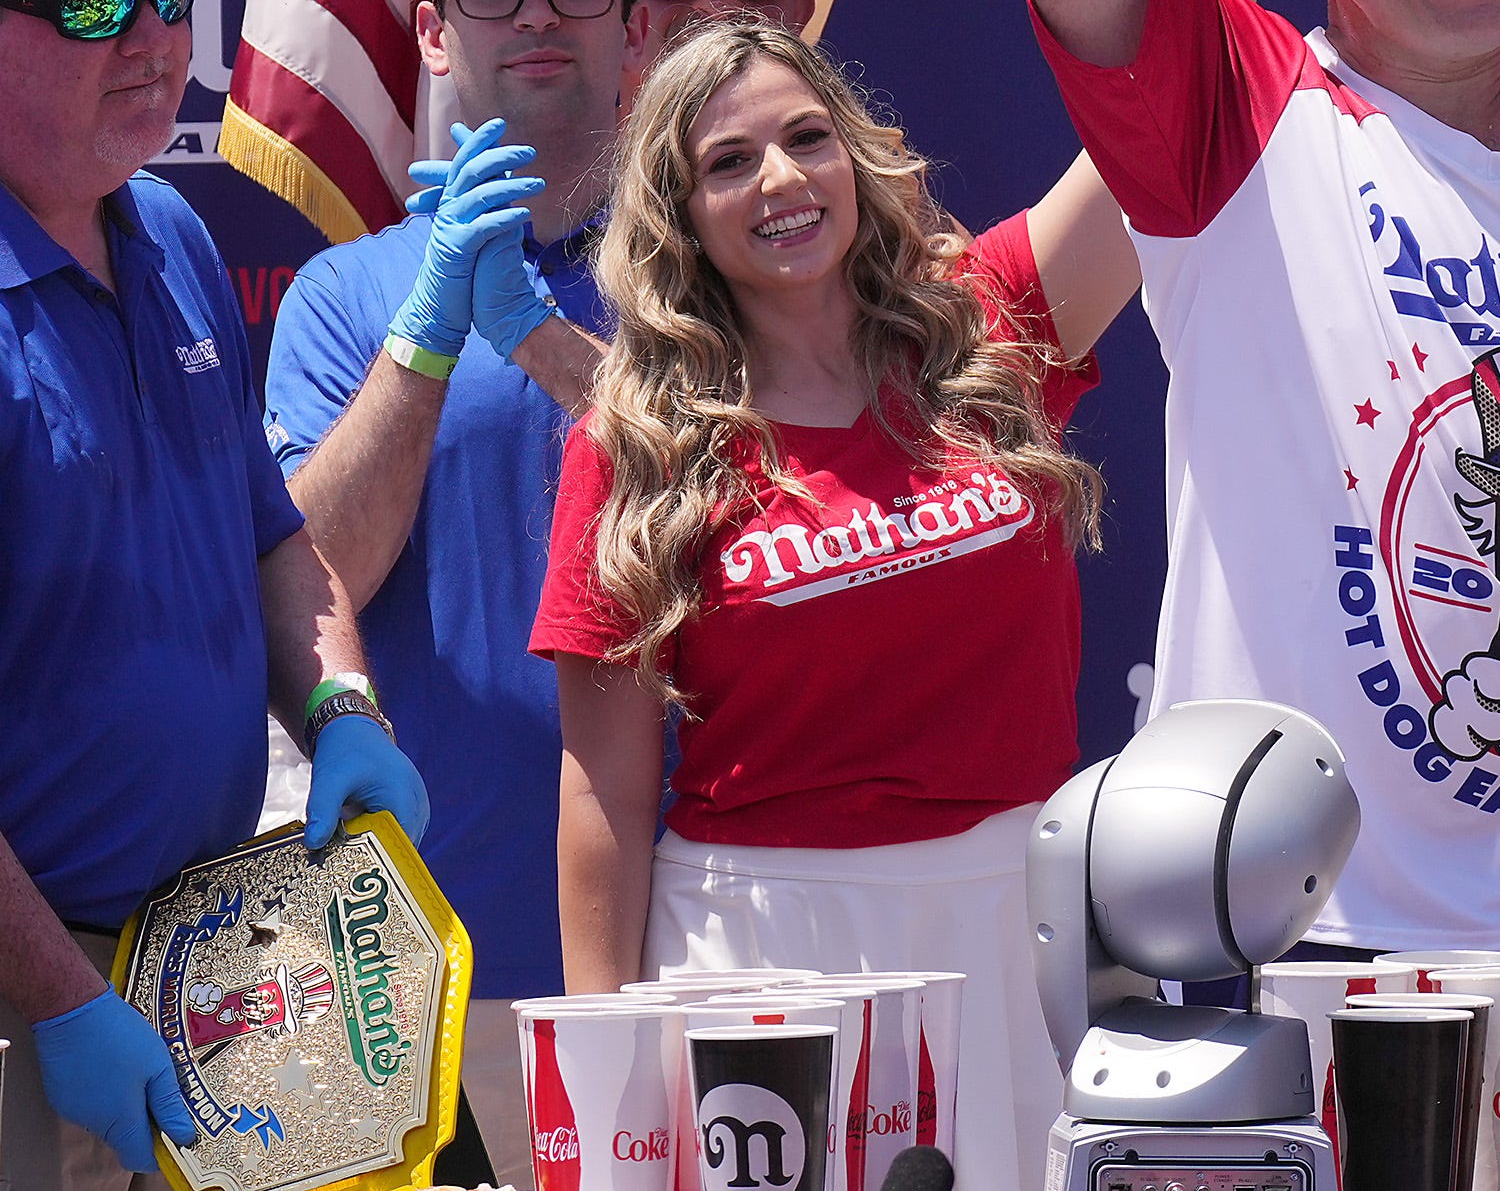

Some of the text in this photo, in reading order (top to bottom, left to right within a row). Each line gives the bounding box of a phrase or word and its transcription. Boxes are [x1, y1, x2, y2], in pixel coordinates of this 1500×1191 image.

[720, 471, 1023, 588] Nathan's
[893, 480, 958, 509] Since 1916
[848, 547, 953, 585] FAMOUS
[1334, 525, 1385, 648] HOT
[1413, 556, 1493, 600] 20
[1358, 659, 1456, 782] DOG
[162, 975, 181, 1039] WORLD
[343, 868, 411, 1077] Nathan's
[169, 1041, 226, 1132] CHAMPION
[612, 1130, 670, 1162] Coke
